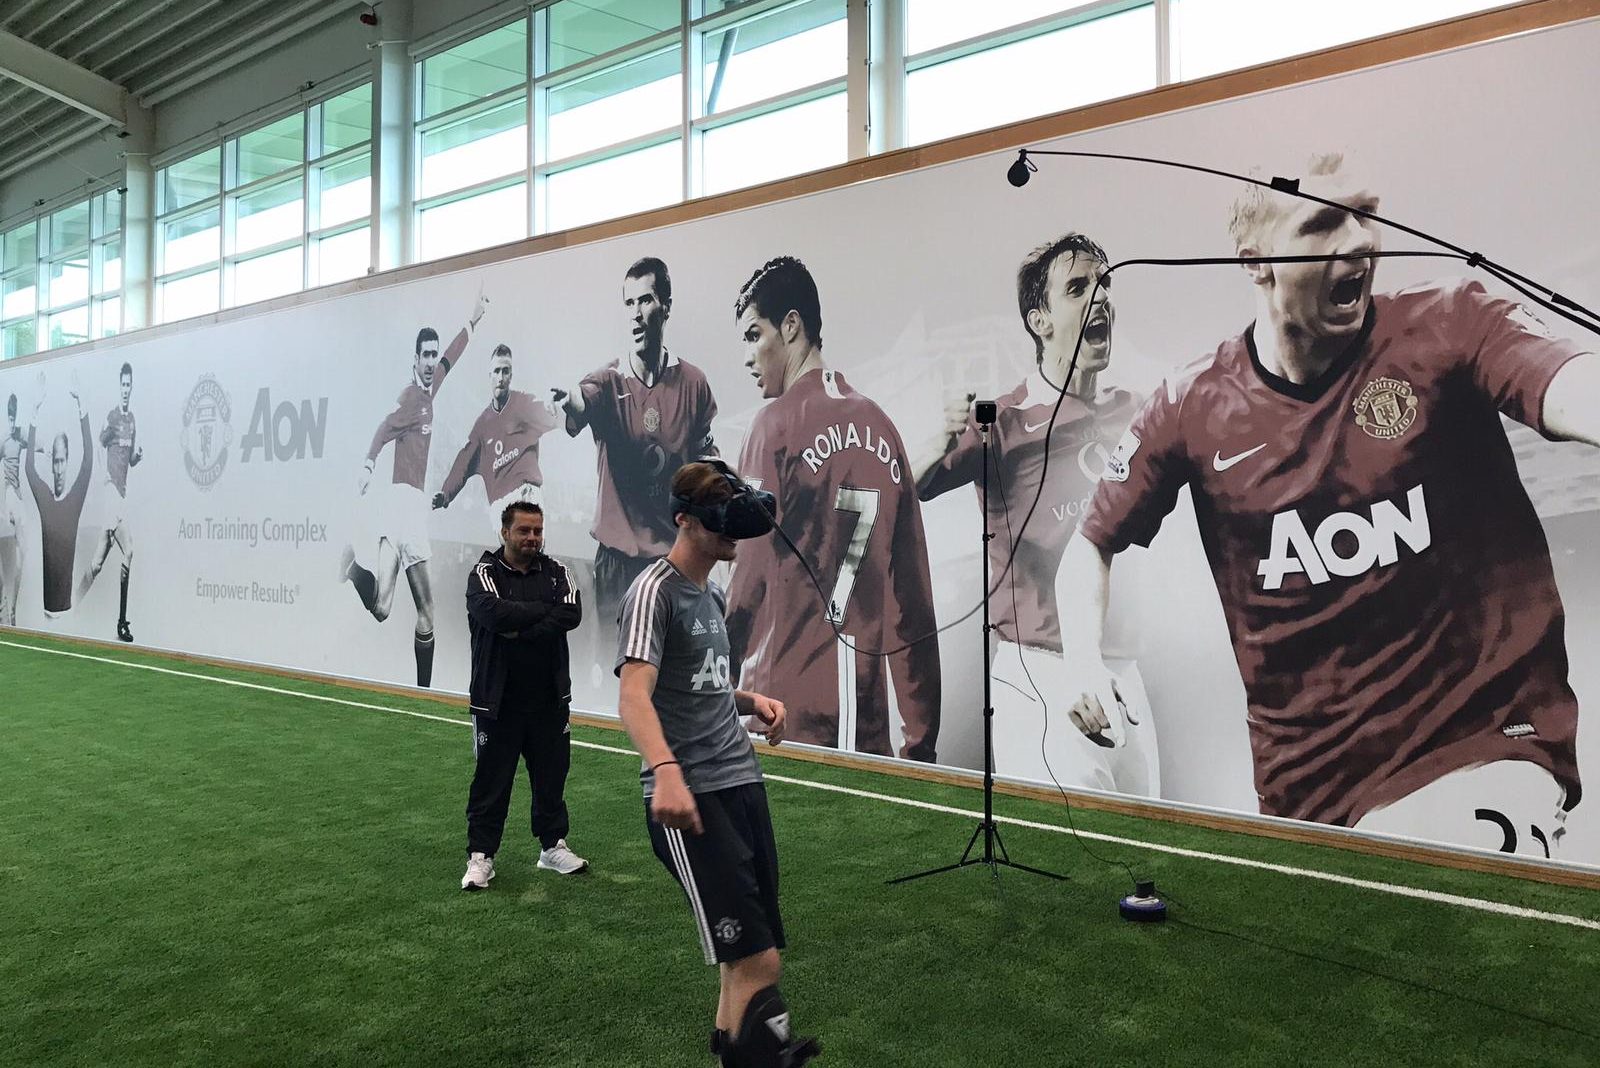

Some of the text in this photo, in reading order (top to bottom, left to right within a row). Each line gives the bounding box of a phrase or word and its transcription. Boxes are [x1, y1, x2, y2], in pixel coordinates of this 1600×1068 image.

[1358, 382, 1407, 409] MANCHESTER
[1375, 418, 1410, 436] UNITED
[801, 422, 901, 484] RONALDO
[178, 516, 328, 550] Aon Training Complex
[1257, 483, 1432, 590] AON
[824, 485, 881, 625] 7
[196, 577, 249, 604] Empower
